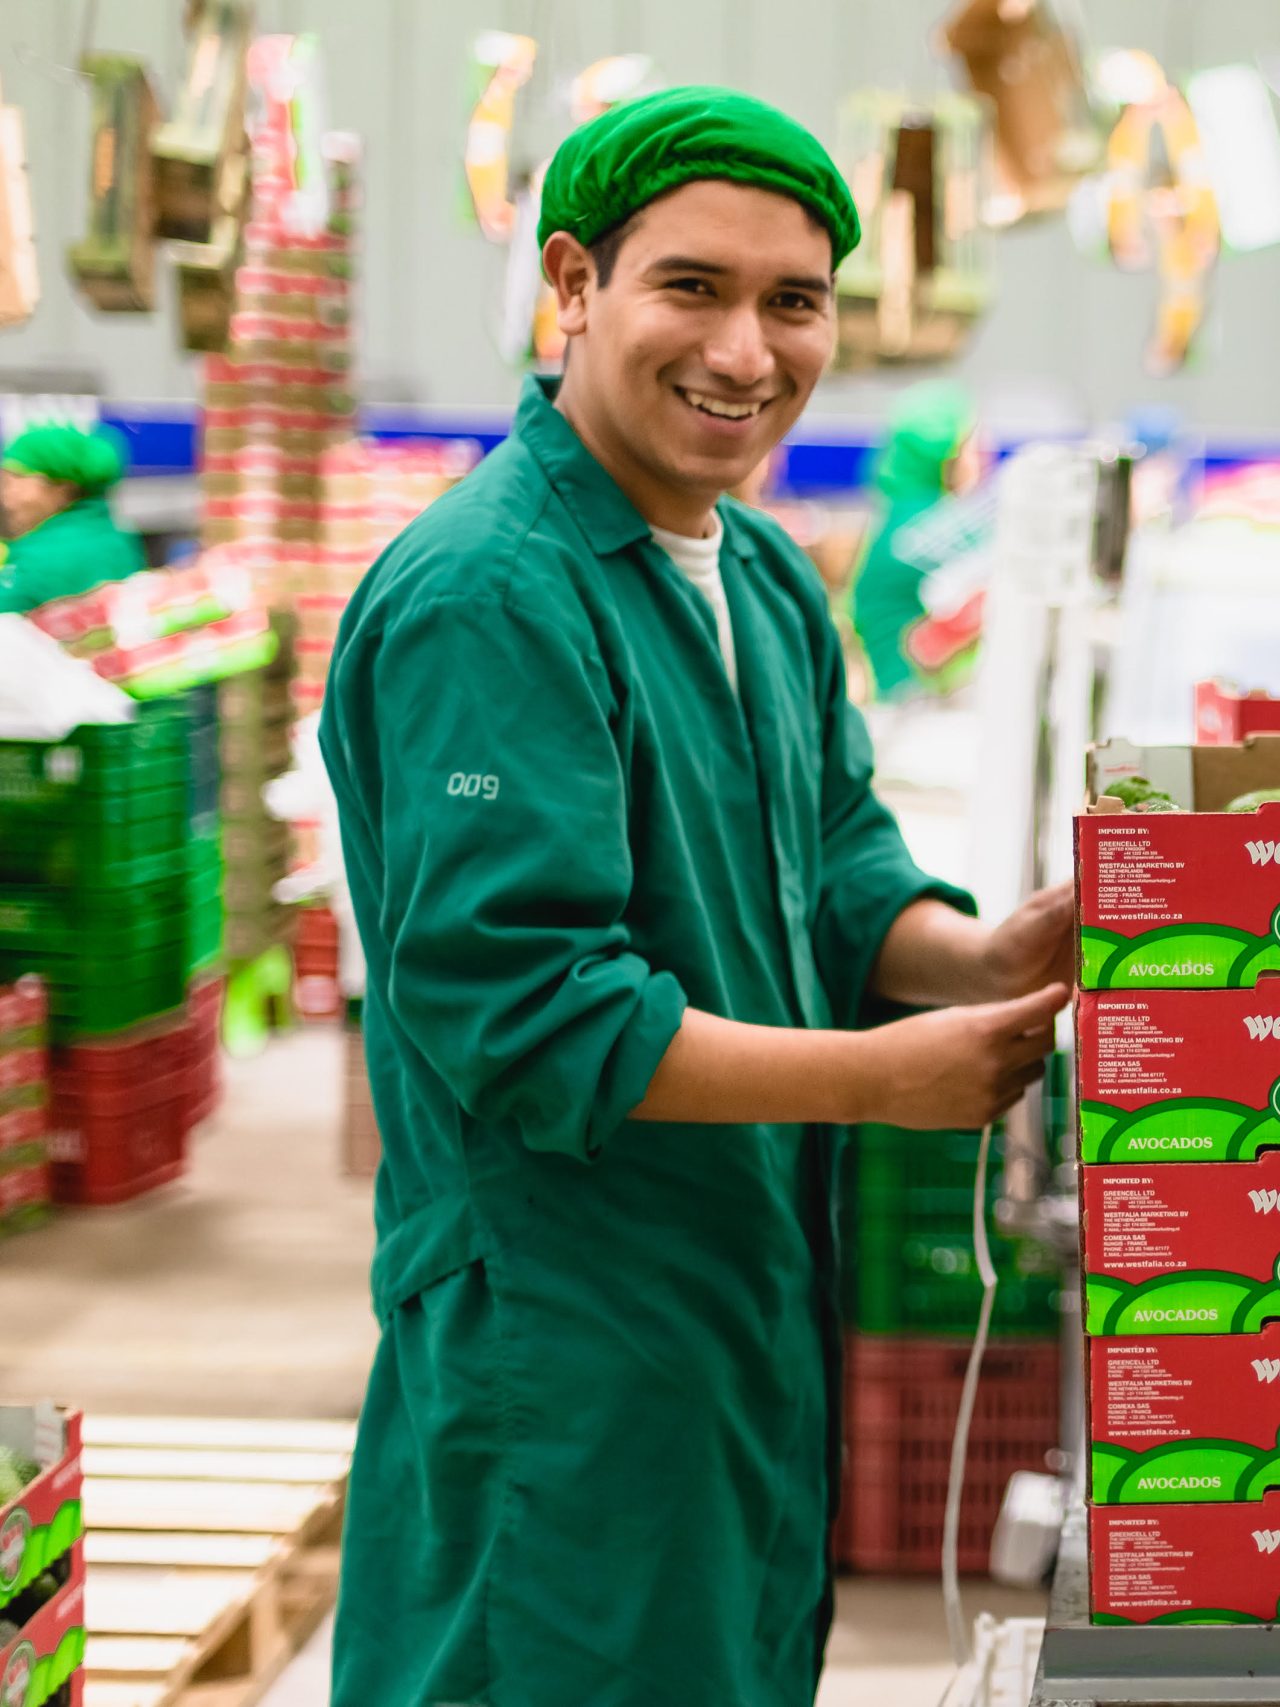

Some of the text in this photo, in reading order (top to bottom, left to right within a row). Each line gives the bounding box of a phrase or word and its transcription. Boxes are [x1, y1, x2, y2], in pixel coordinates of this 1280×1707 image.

[447, 771, 500, 800] 009
[1128, 963, 1214, 976] AVOCADOS
[1128, 1137, 1213, 1150] AVOCADOS
[1133, 1310, 1218, 1323] AVOCADOS
[1137, 1478, 1221, 1491] AVOCADOS
